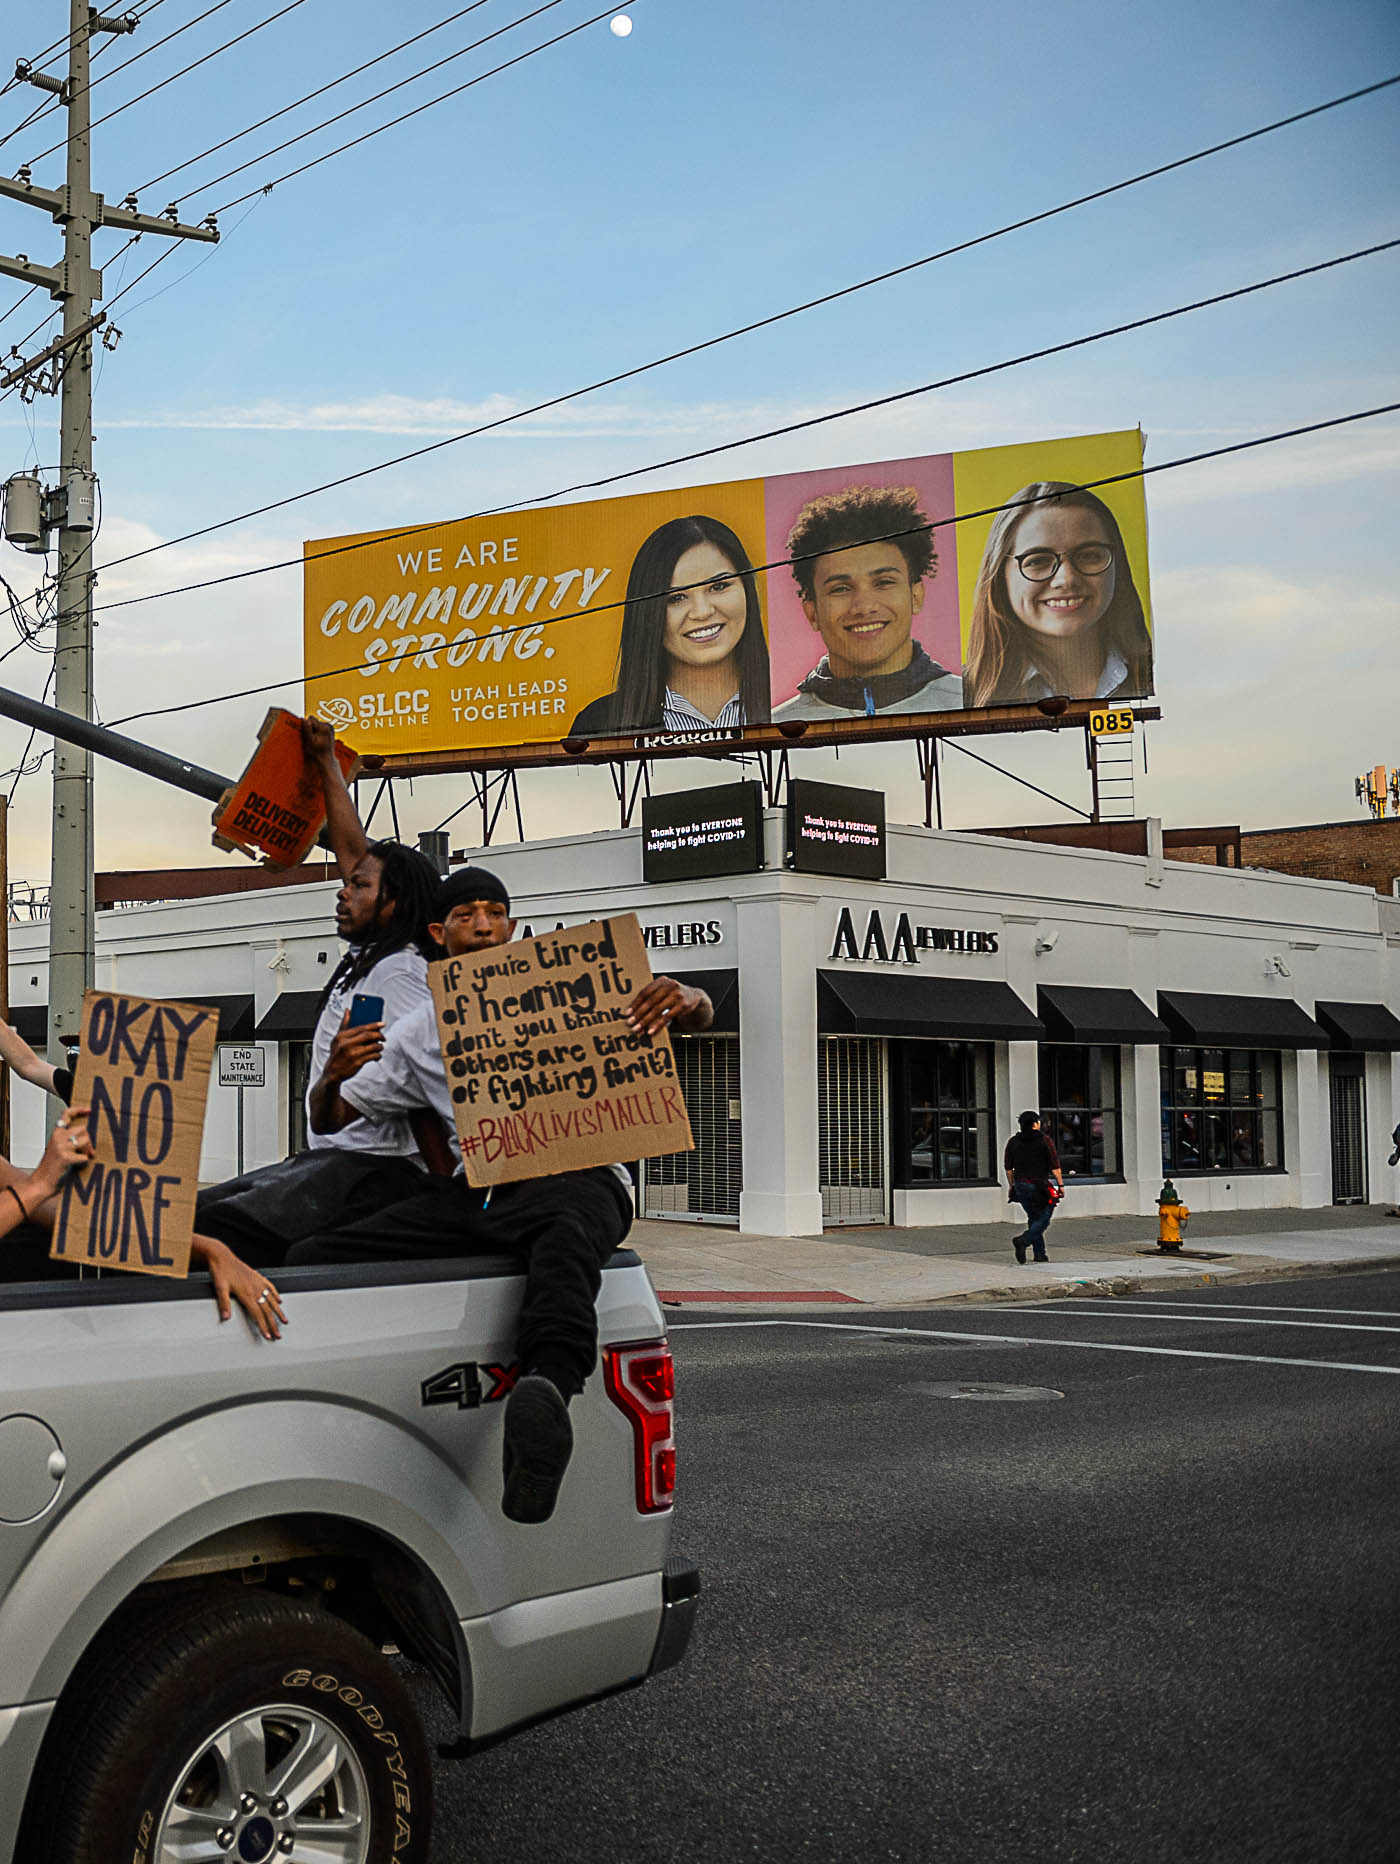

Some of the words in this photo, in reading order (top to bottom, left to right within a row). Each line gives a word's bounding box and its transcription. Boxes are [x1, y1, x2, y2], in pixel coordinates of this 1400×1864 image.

[397, 548, 444, 576] WE
[455, 538, 519, 569] ARE
[320, 568, 611, 637] COMMUNITY
[358, 621, 555, 678] STRONG.
[358, 689, 430, 717] SLCC
[451, 685, 500, 703] UTAH
[507, 679, 568, 698] LEADS
[452, 698, 566, 723] TOGETHER
[360, 714, 429, 730] ONLINE
[1093, 712, 1132, 732] 085
[233, 808, 299, 854] DELIVERY!
[244, 791, 310, 837] DELIVERY!
[650, 826, 675, 838] Thank
[676, 825, 690, 836] you
[692, 823, 700, 832] to
[701, 817, 743, 831] EVERYONE
[647, 840, 677, 851] helping
[687, 835, 706, 847] fight
[707, 830, 745, 843] COVID-19
[534, 919, 617, 970] tired
[828, 907, 920, 963] AAA
[914, 926, 999, 953] JEWELERS
[442, 995, 470, 1026] of
[478, 972, 597, 1024] hearing
[598, 961, 632, 995] it
[88, 997, 209, 1081] OKAY
[514, 1017, 557, 1048] you
[230, 1063, 255, 1071] STATE
[233, 1051, 251, 1059] END
[221, 1073, 264, 1083] MAINTENANCE
[452, 1078, 480, 1104] of
[487, 1064, 598, 1112] fighting
[87, 1075, 174, 1166] NO
[56, 1163, 181, 1267] MORE
[282, 1668, 412, 1864] GOODYEA
